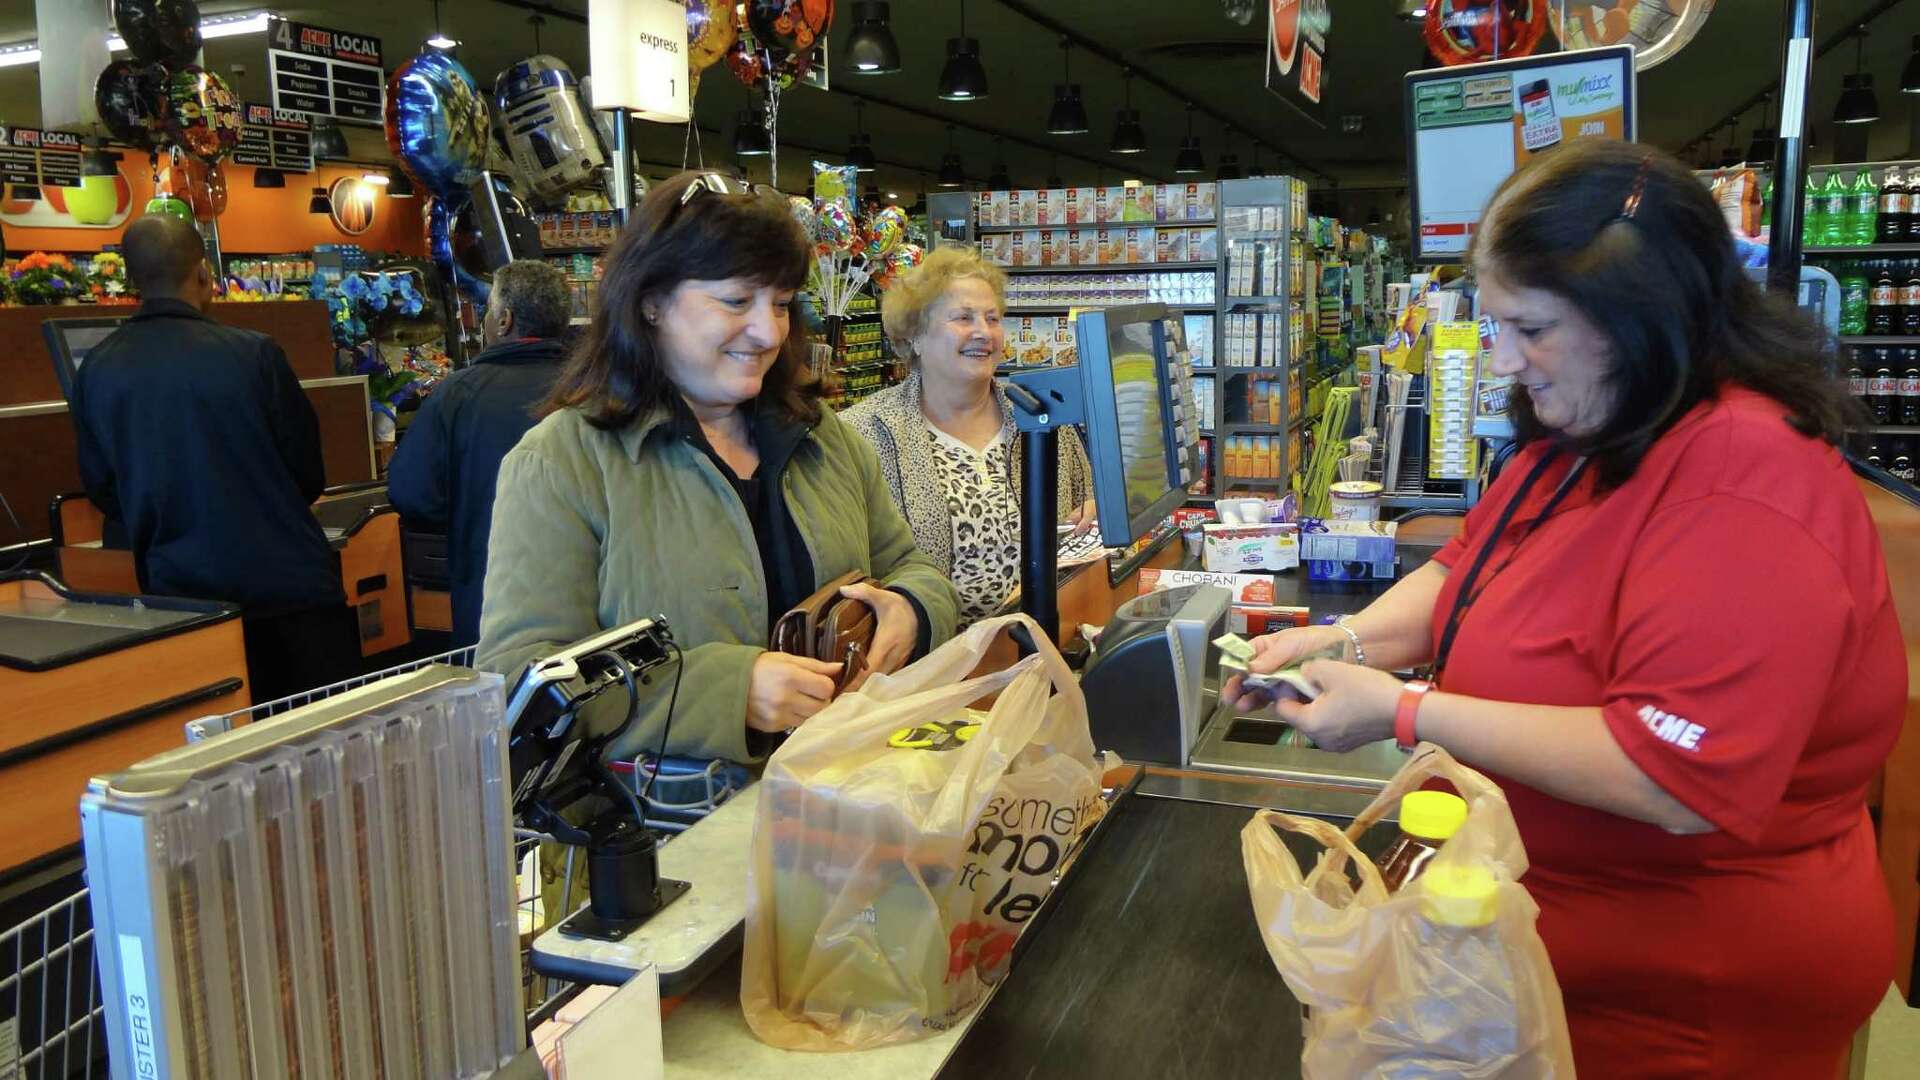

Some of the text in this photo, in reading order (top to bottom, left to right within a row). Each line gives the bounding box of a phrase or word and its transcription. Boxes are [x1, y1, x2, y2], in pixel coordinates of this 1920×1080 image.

[276, 21, 293, 50] 4
[301, 28, 332, 47] ACME
[333, 34, 378, 56] LOCAL
[640, 32, 678, 53] express
[670, 79, 675, 97] 1
[274, 109, 309, 124] LOCAL
[41, 132, 78, 145] LOCAL
[1172, 572, 1237, 586] CHOBANI
[1637, 704, 1707, 752] ACME
[130, 994, 146, 1009] 3
